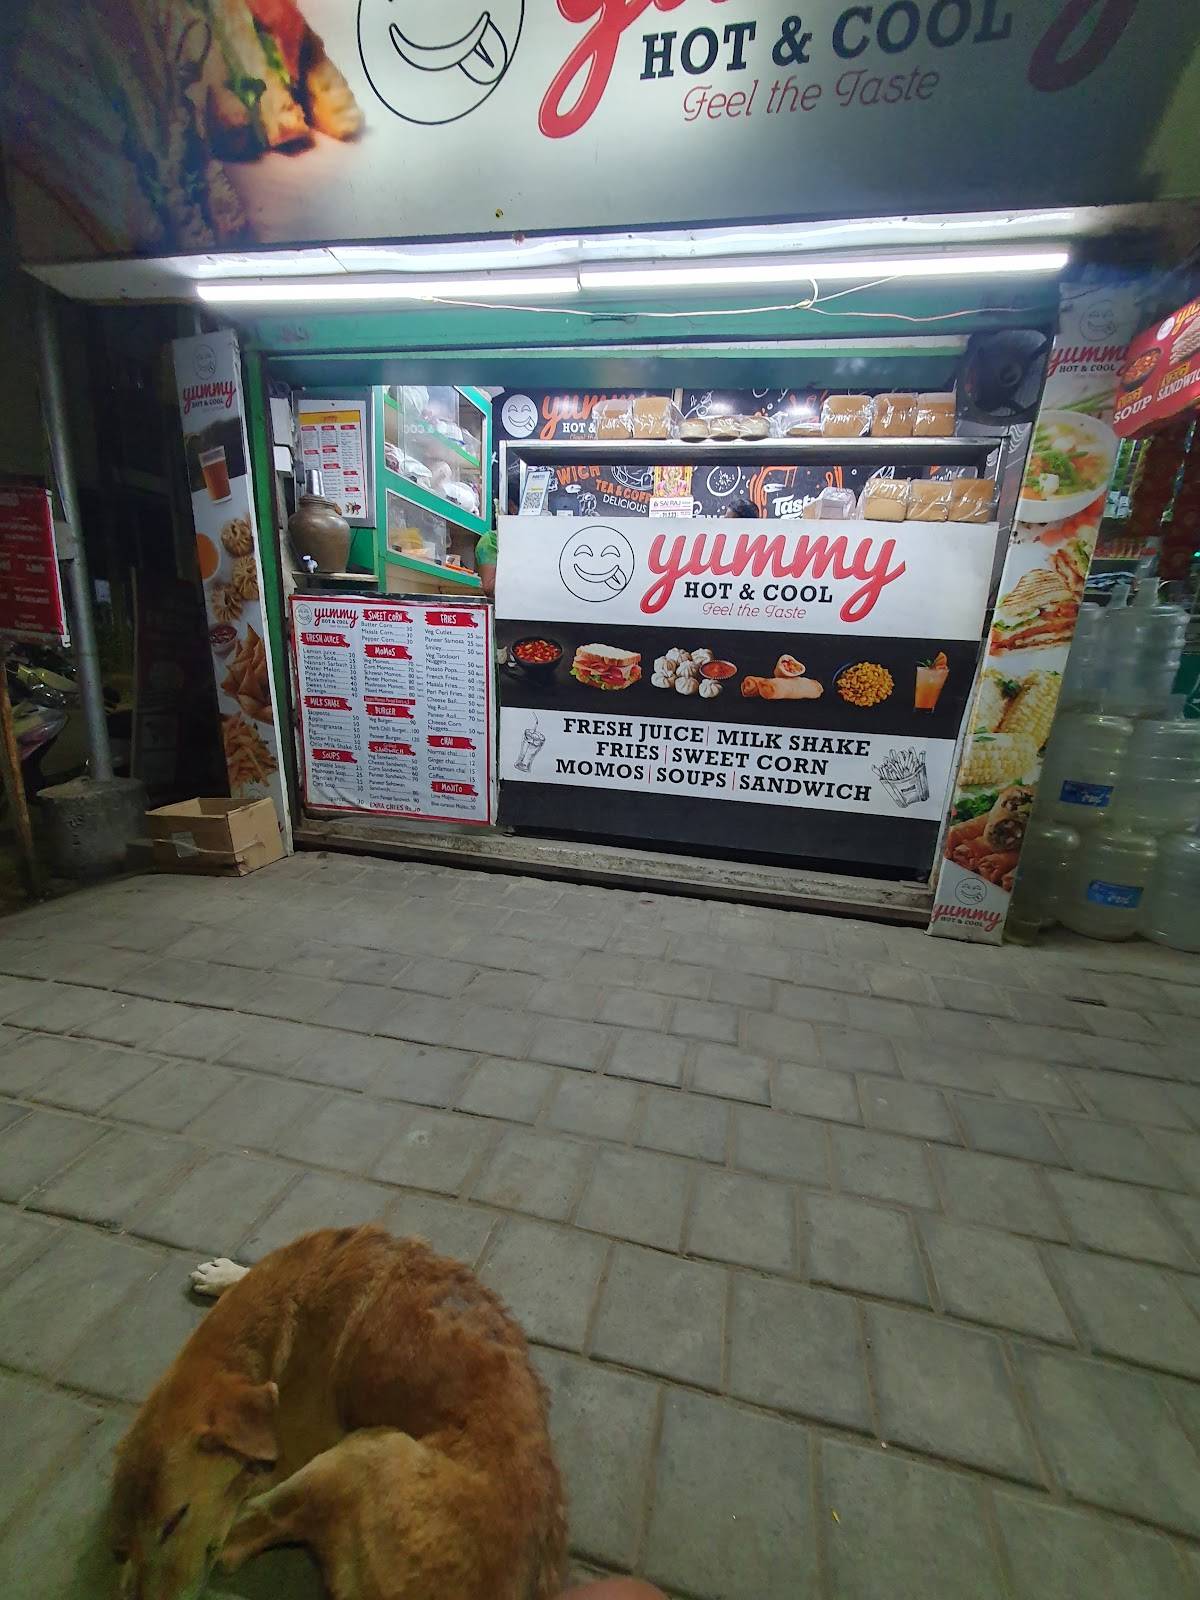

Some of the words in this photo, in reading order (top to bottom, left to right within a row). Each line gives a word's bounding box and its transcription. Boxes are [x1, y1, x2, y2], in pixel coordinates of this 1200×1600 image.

[640, 20, 756, 81] HOT
[772, 15, 812, 66] &
[832, 0, 1011, 60] COOL
[683, 79, 759, 121] Feel
[766, 75, 822, 114] the
[835, 65, 940, 108] Taste
[1059, 364, 1078, 373] HOT
[1090, 364, 1116, 372] COOL
[183, 380, 236, 415] yummy
[1157, 368, 1200, 402] SANDWIC
[1113, 395, 1152, 425] SOUP
[562, 422, 586, 433] HOT
[595, 478, 614, 495] TEA
[623, 487, 653, 504] COFF
[602, 494, 647, 514] DELICIOUS
[639, 532, 906, 623] yummy
[684, 581, 732, 599] HOT
[739, 583, 754, 600] &
[763, 584, 833, 603] COOL
[314, 607, 358, 628] yummy
[368, 611, 386, 621] SWEET
[440, 614, 457, 624] FRIES
[702, 602, 733, 616] Feel
[737, 603, 760, 617] the
[765, 604, 807, 619] Taste
[564, 718, 633, 738] FRESH
[638, 723, 704, 743] JUICE
[716, 729, 783, 750] MILK
[788, 735, 871, 757] SHAKE
[596, 741, 659, 761] FRIES
[672, 747, 750, 768] SWEET
[756, 754, 829, 776] CORN
[555, 758, 644, 780] MOMOS
[656, 767, 727, 788] SOUPS
[739, 774, 872, 801] SANDWICH
[930, 904, 1002, 932] yummy
